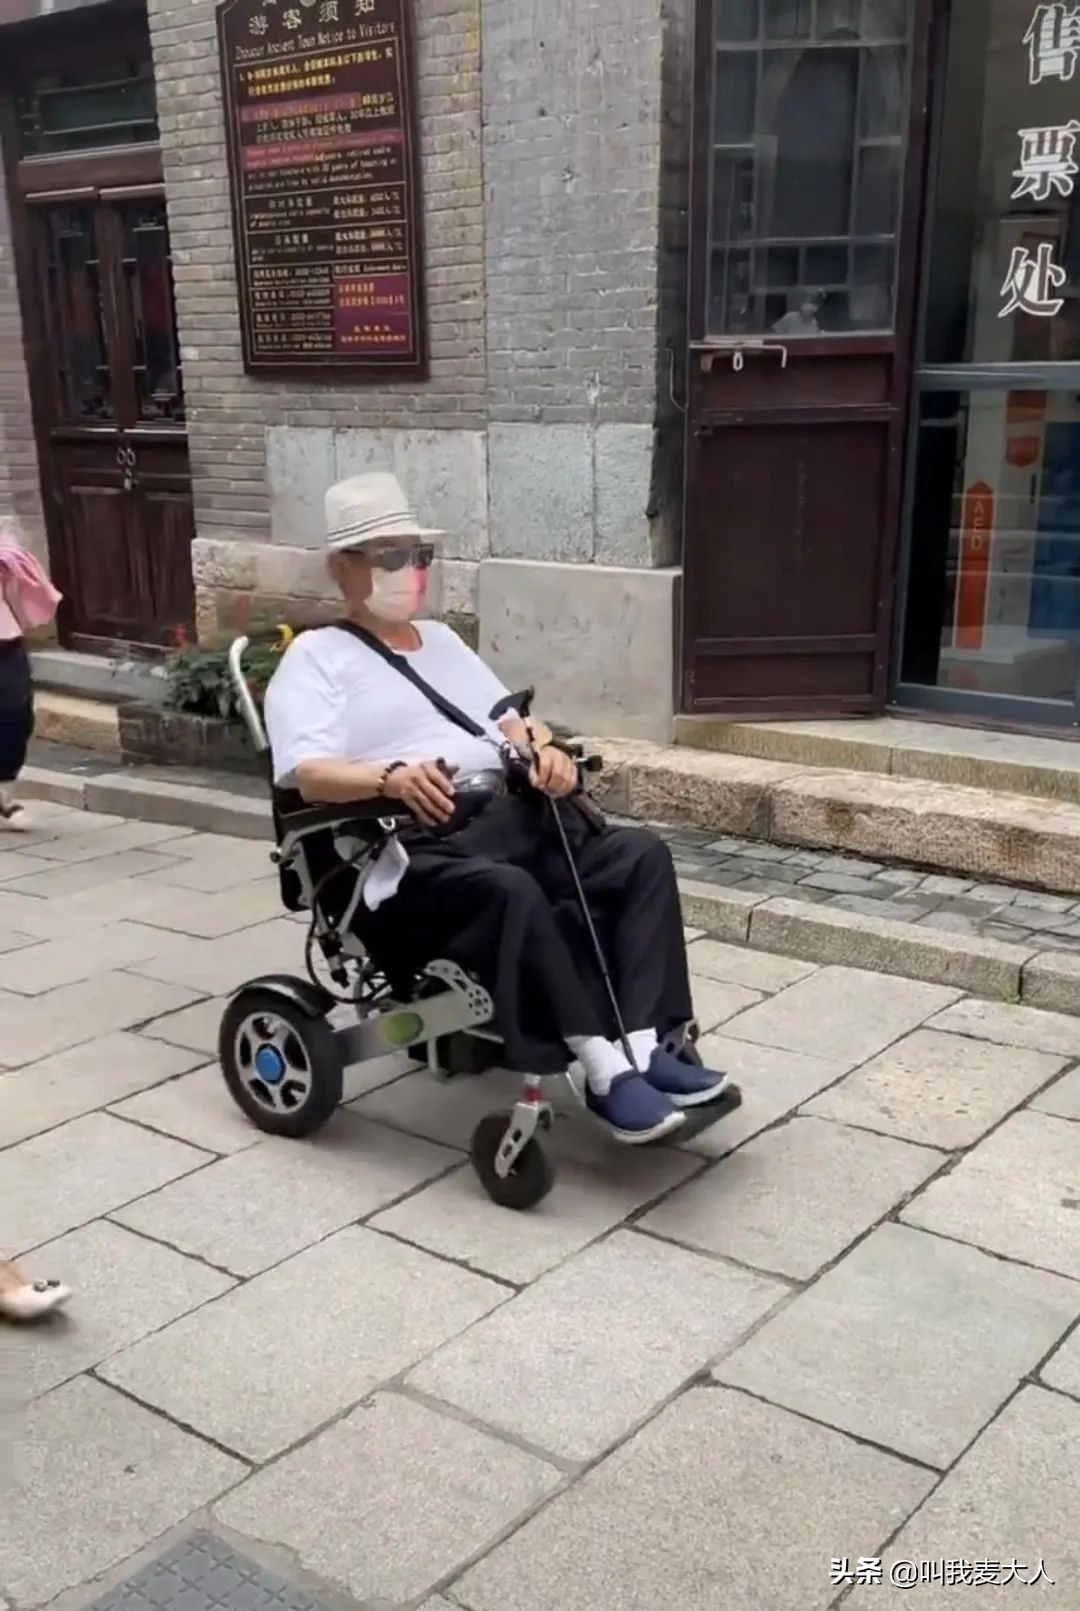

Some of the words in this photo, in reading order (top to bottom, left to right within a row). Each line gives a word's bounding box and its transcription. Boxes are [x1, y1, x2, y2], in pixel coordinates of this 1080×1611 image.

[248, 0, 376, 35] 游客须知
[267, 38, 295, 54] Ancient
[297, 34, 316, 49] Town
[317, 28, 344, 46] Notice
[346, 28, 357, 41] to
[358, 21, 396, 38] Visitors
[998, 4, 1080, 318] 售票处
[970, 500, 985, 551] AED
